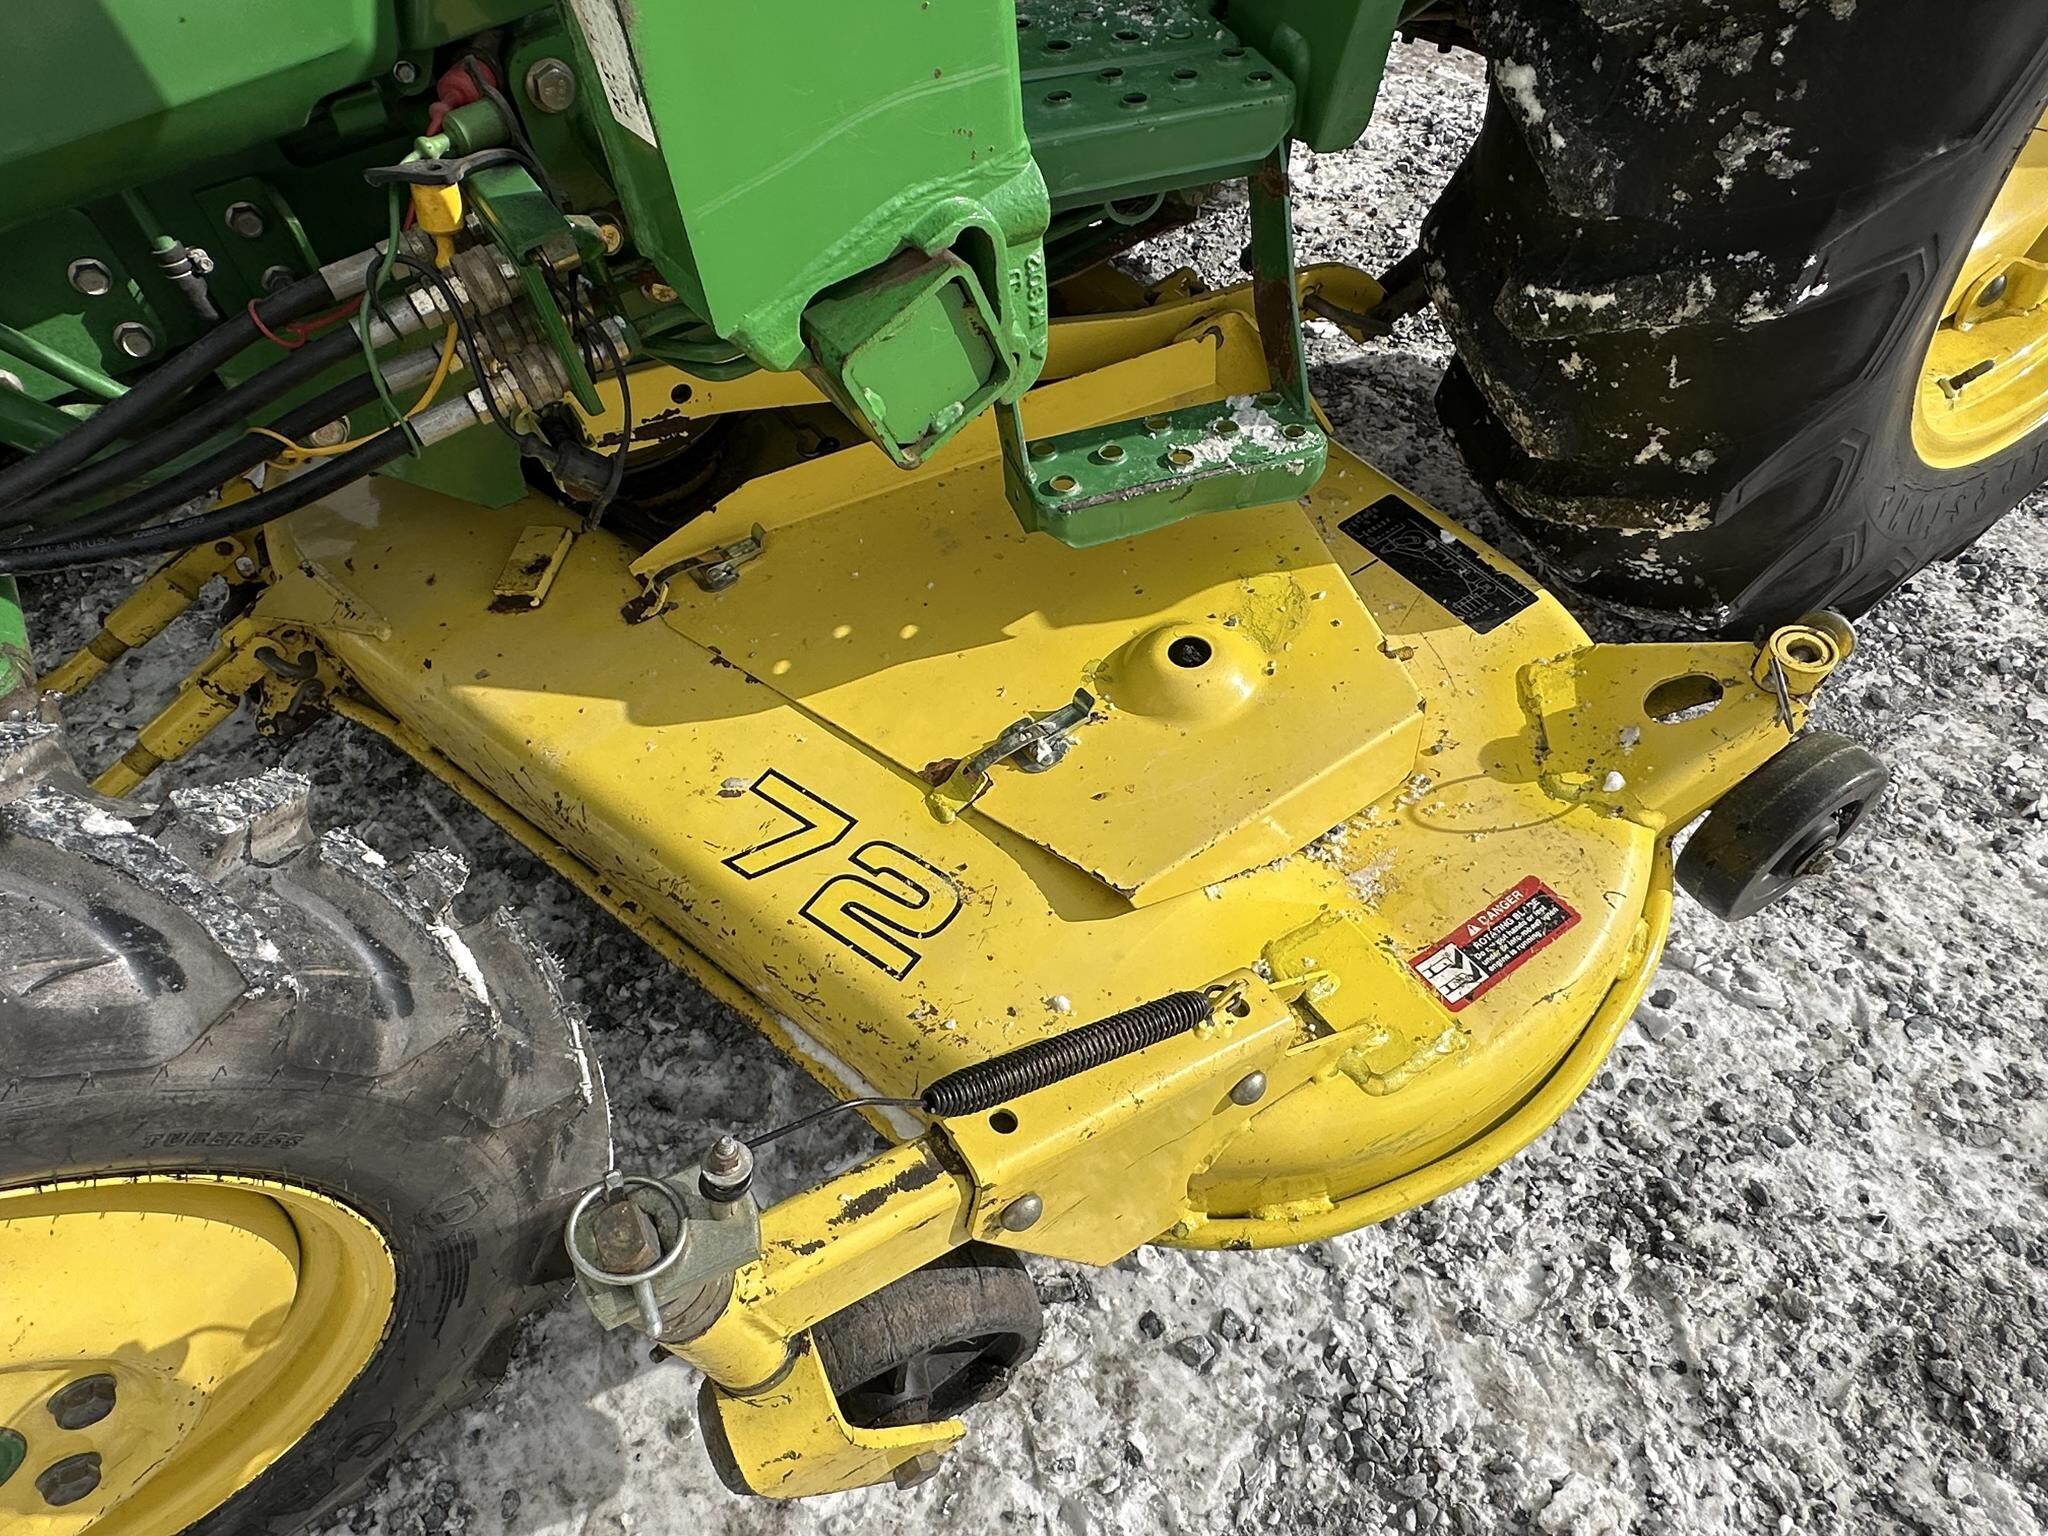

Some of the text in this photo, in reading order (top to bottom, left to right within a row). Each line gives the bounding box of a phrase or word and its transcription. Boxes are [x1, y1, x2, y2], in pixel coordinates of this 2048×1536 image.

[87, 536, 118, 549] USA
[721, 767, 964, 982] 72
[1472, 898, 1541, 950] ROTATING BLADE
[1477, 890, 1524, 926] DANGER
[1473, 951, 1486, 960] Do
[1506, 920, 1528, 936] hands
[1526, 914, 1534, 922] or
[1488, 953, 1511, 972] engine
[1509, 948, 1517, 956] is
[142, 1129, 305, 1150] TUBELESS
